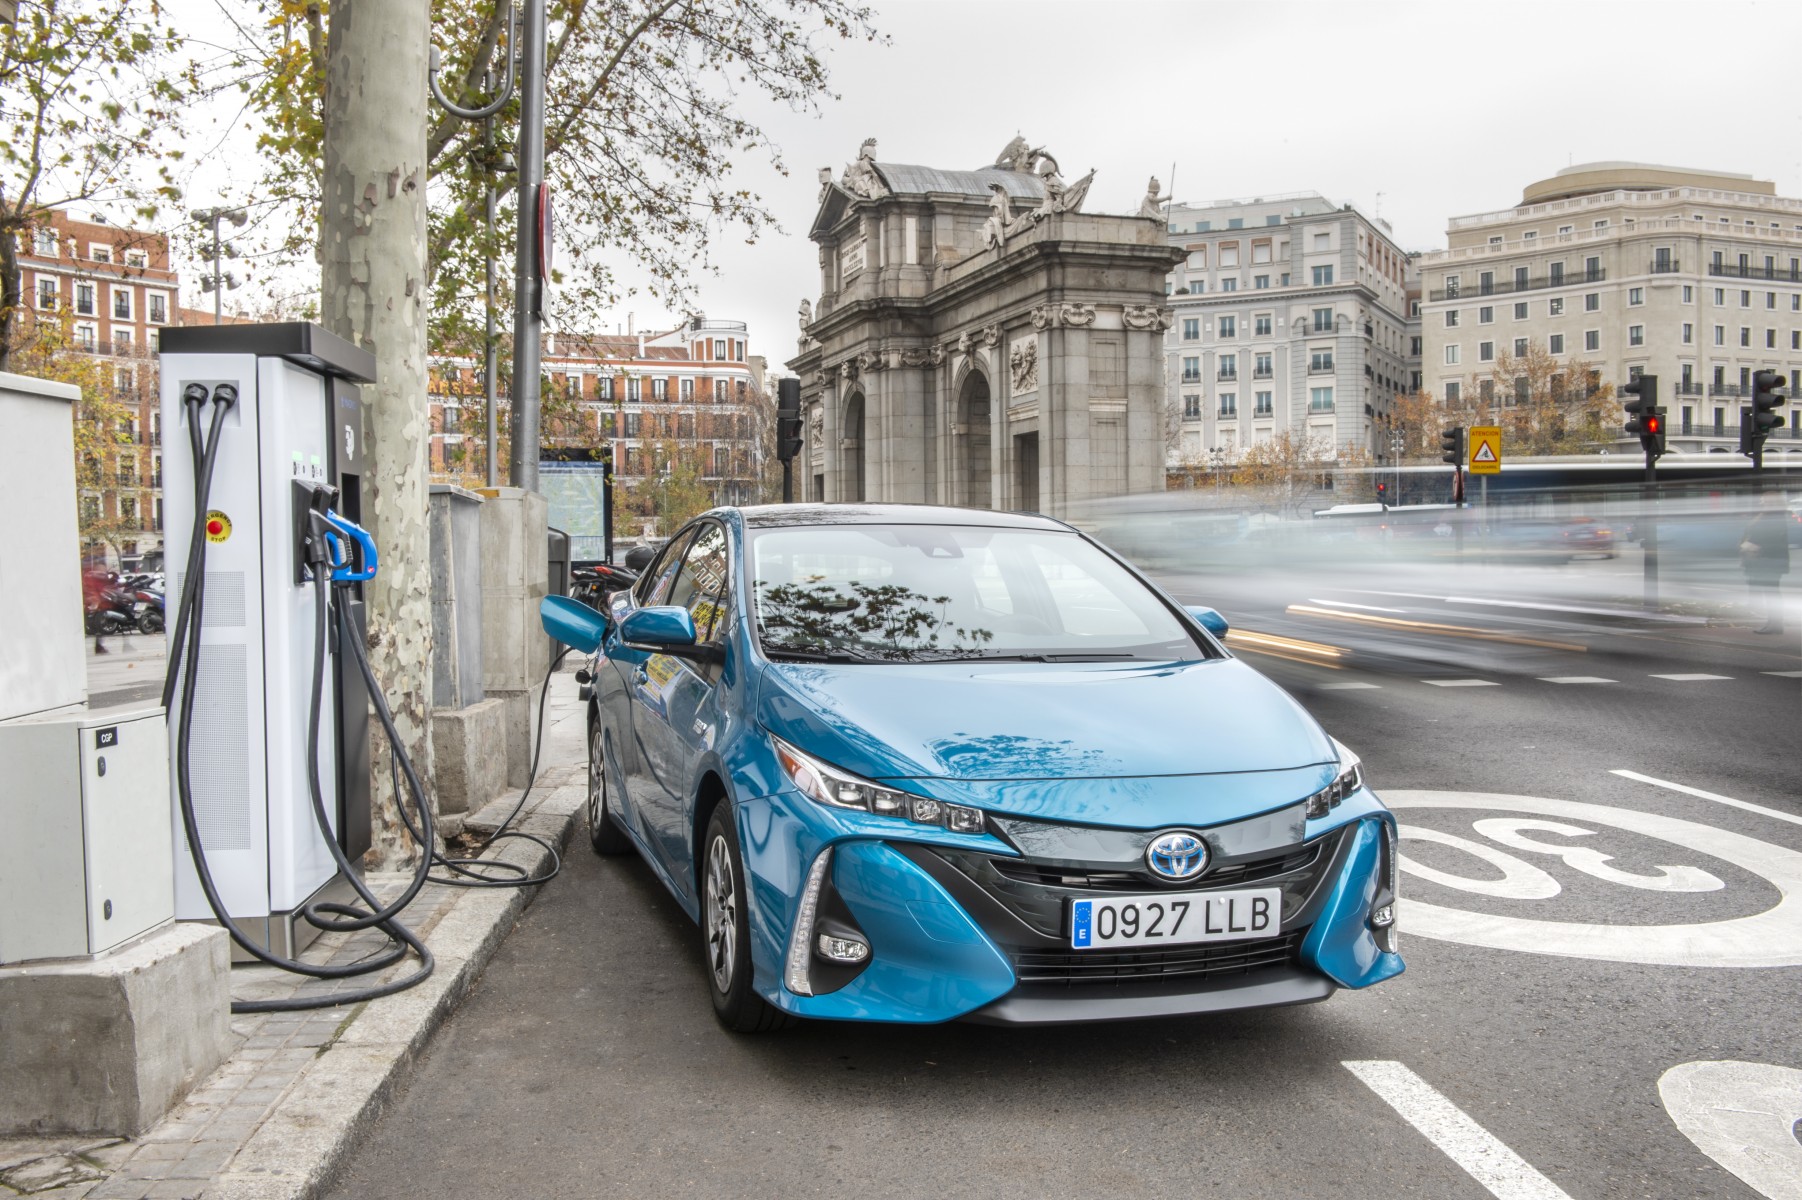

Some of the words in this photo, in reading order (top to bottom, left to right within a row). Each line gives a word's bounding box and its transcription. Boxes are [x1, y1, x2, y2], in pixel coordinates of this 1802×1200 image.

[206, 513, 231, 526] ERGENCY
[101, 732, 113, 743] CGP
[1398, 817, 1726, 900] 30
[1097, 901, 1190, 940] 0927
[1205, 897, 1270, 934] LLB
[1078, 929, 1086, 939] E
